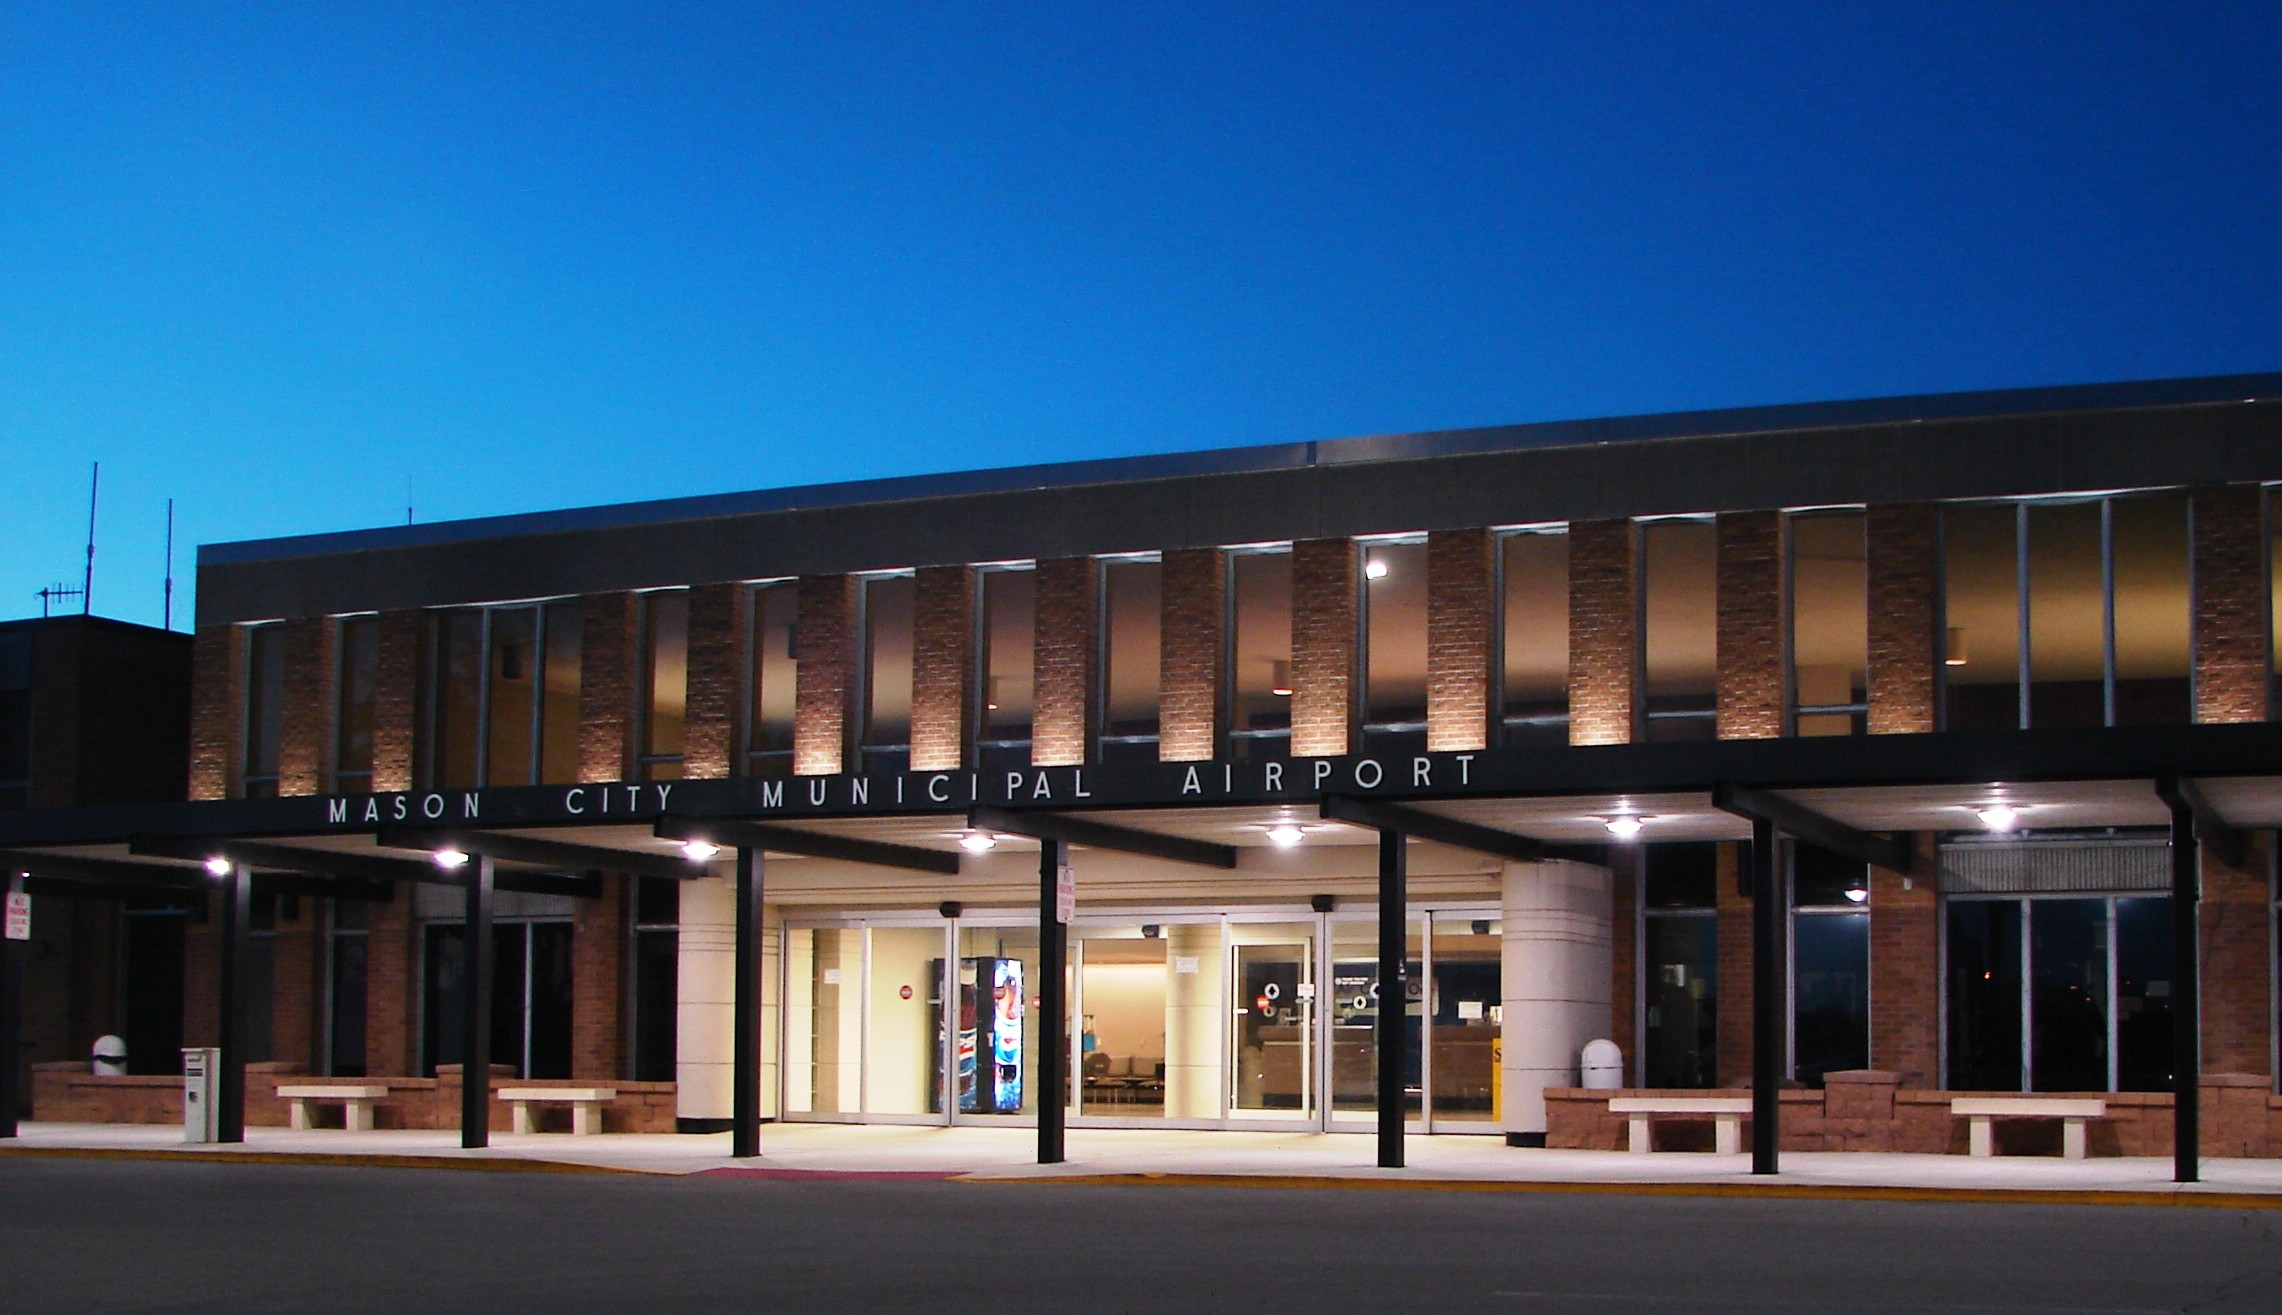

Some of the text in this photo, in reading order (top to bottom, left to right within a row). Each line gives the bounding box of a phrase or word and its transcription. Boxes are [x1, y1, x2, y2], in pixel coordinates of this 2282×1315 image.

[330, 755, 1474, 823] MASON CITY MUNICIPAL AIRPORT
